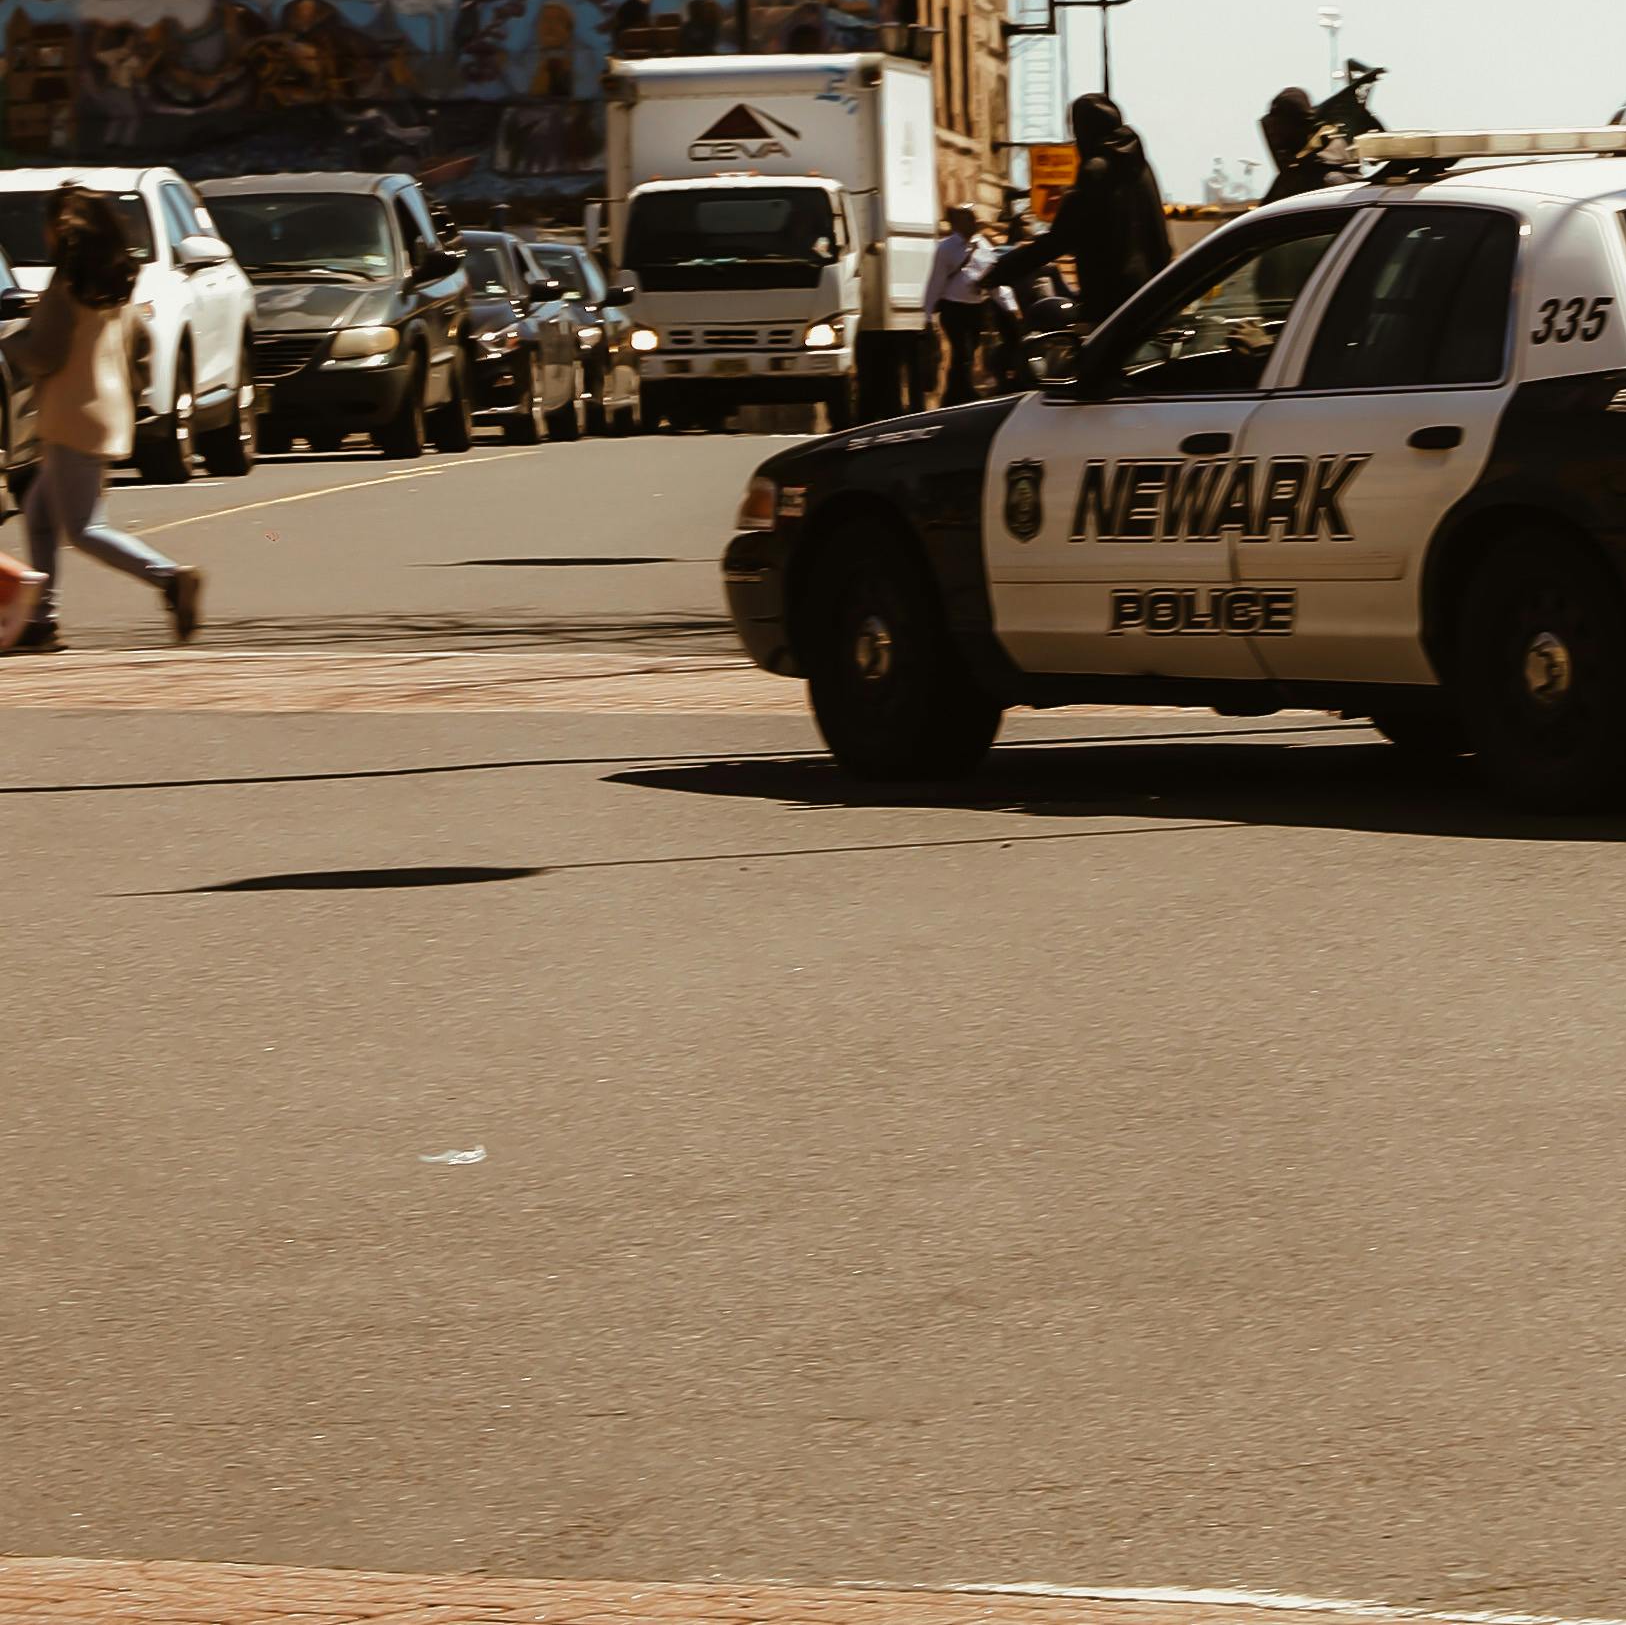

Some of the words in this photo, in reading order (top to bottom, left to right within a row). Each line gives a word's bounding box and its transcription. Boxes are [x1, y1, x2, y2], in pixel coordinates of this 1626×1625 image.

[689, 140, 792, 161] CEVA
[1530, 296, 1616, 346] 335
[1068, 453, 1374, 543] NEWARK
[1104, 588, 1297, 636] POLICE
